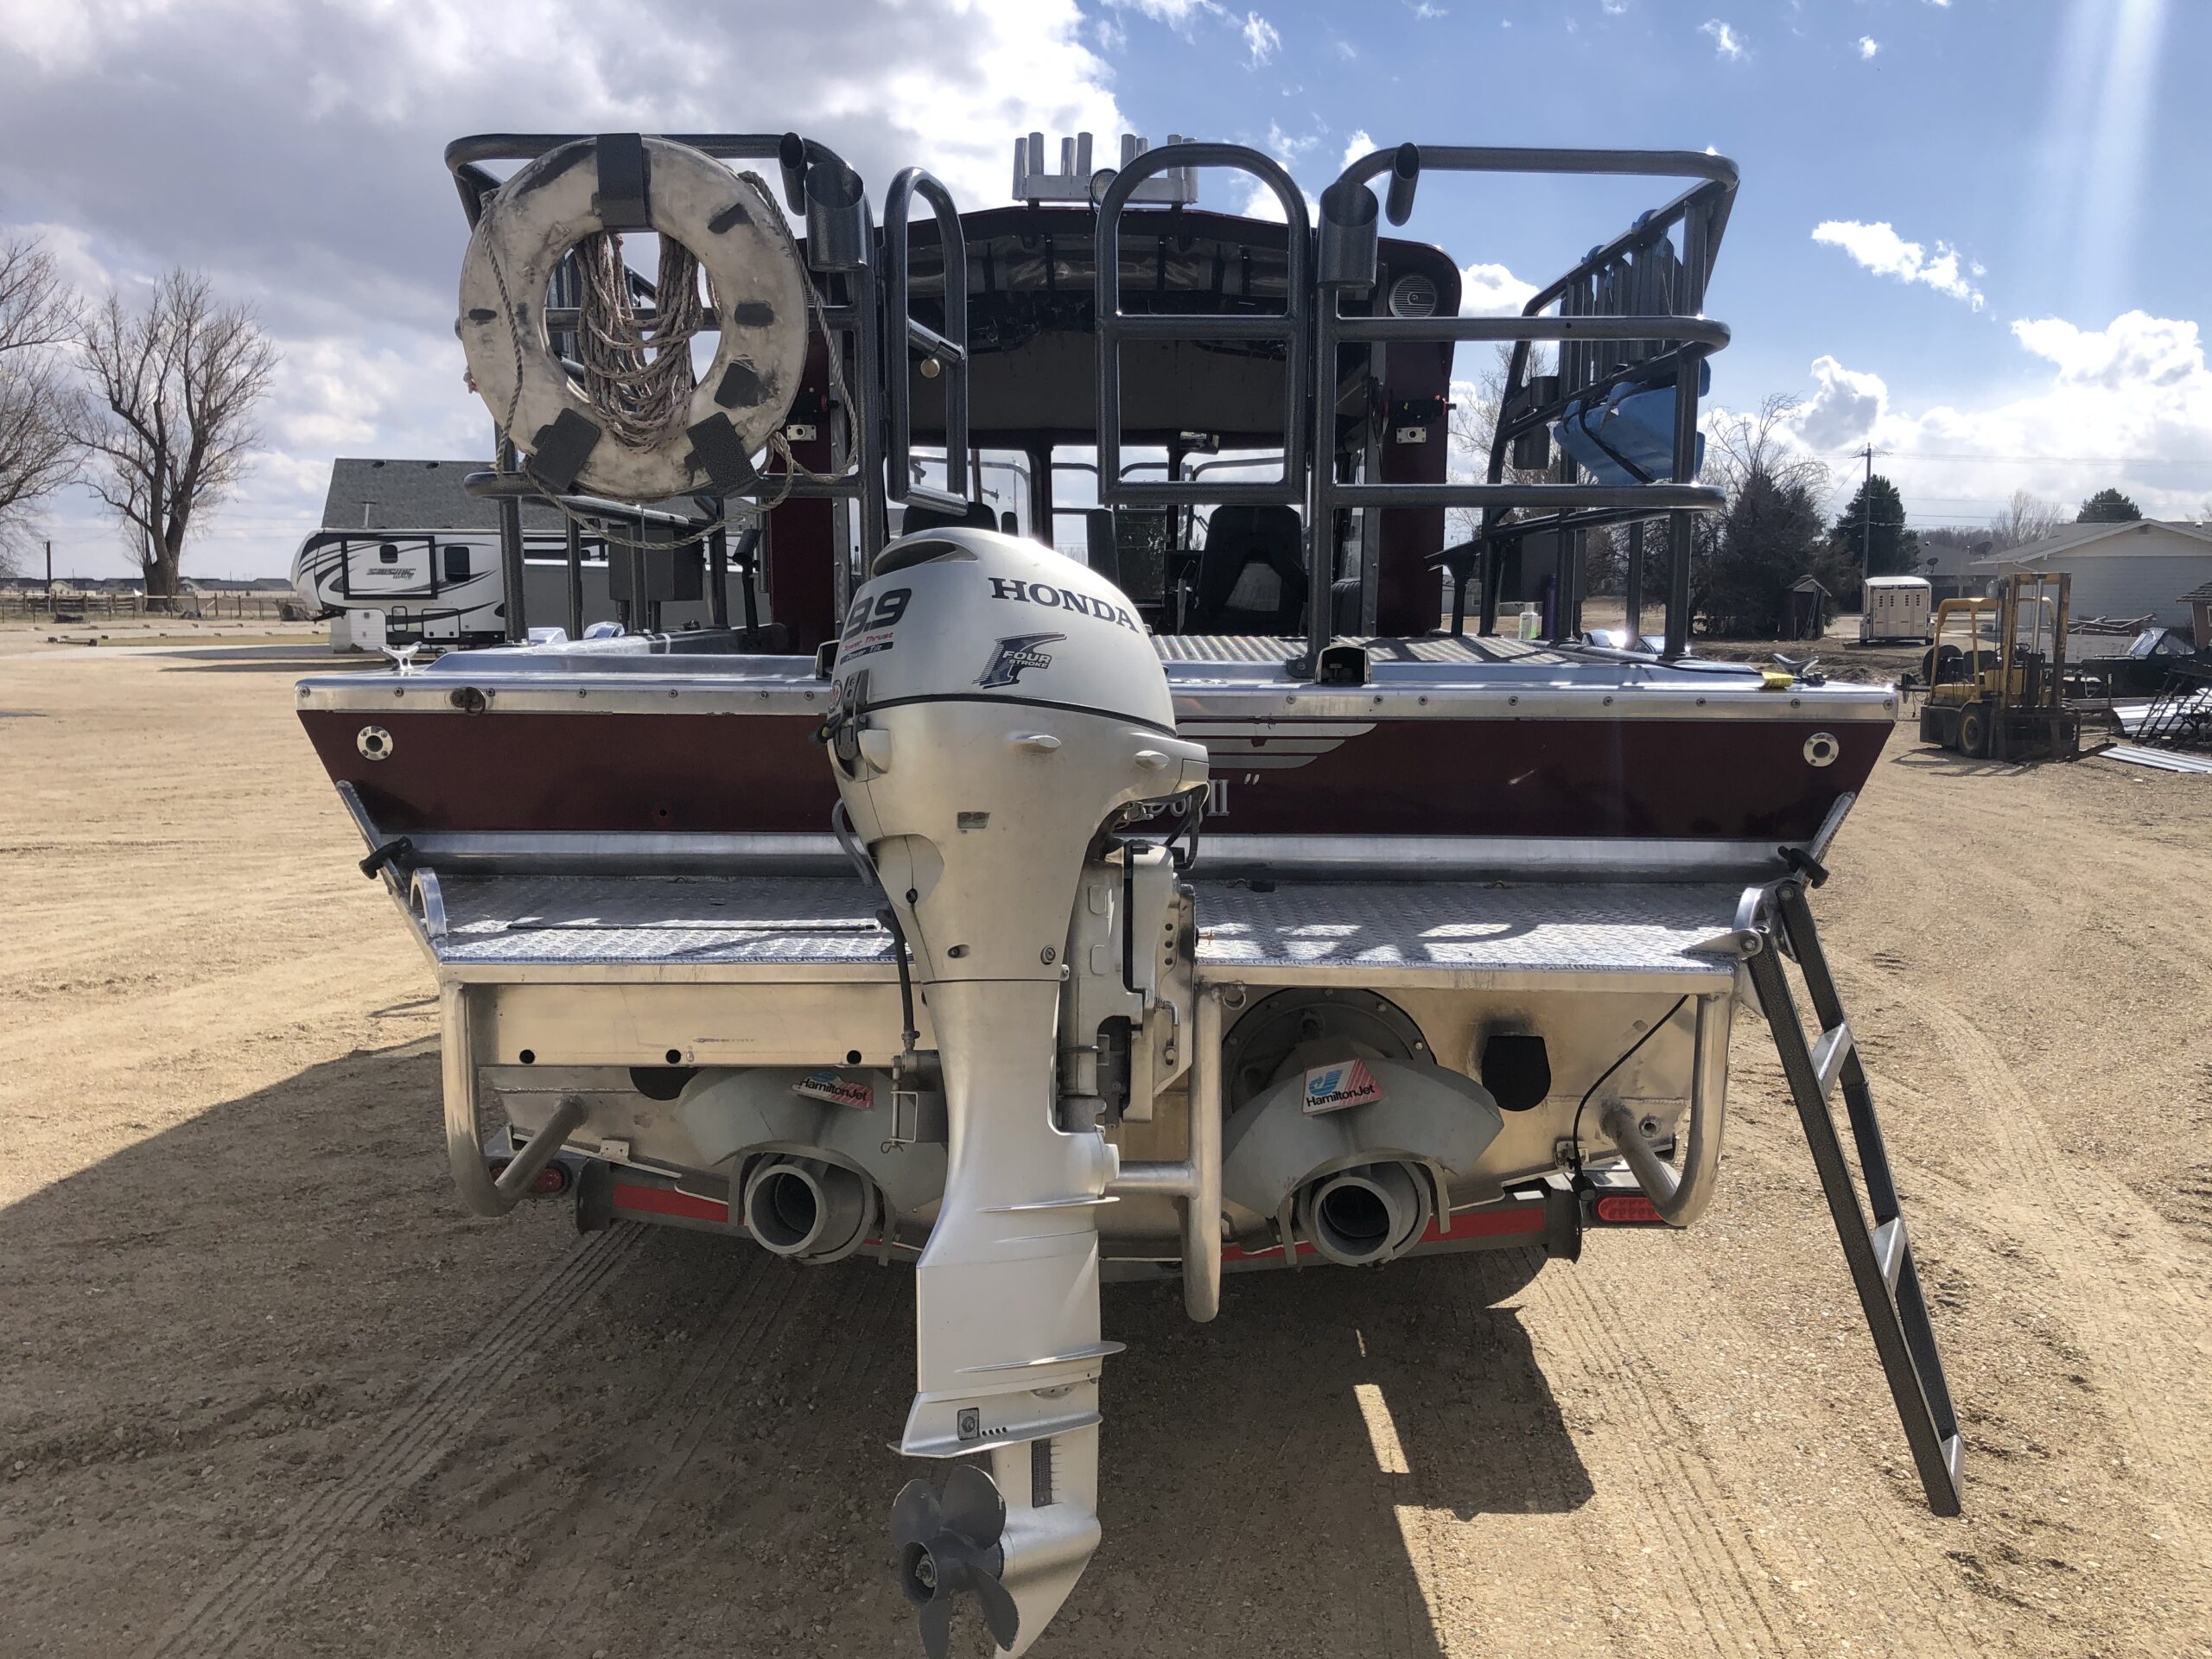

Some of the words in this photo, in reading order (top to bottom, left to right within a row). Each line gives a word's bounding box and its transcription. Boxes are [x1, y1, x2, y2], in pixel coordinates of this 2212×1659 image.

[988, 577, 1139, 633] HONDA
[865, 632, 894, 644] Thrust
[1001, 650, 1052, 664] FOUR
[1008, 658, 1049, 669] STROKE
[1306, 1084, 1375, 1107] HamiltonJet
